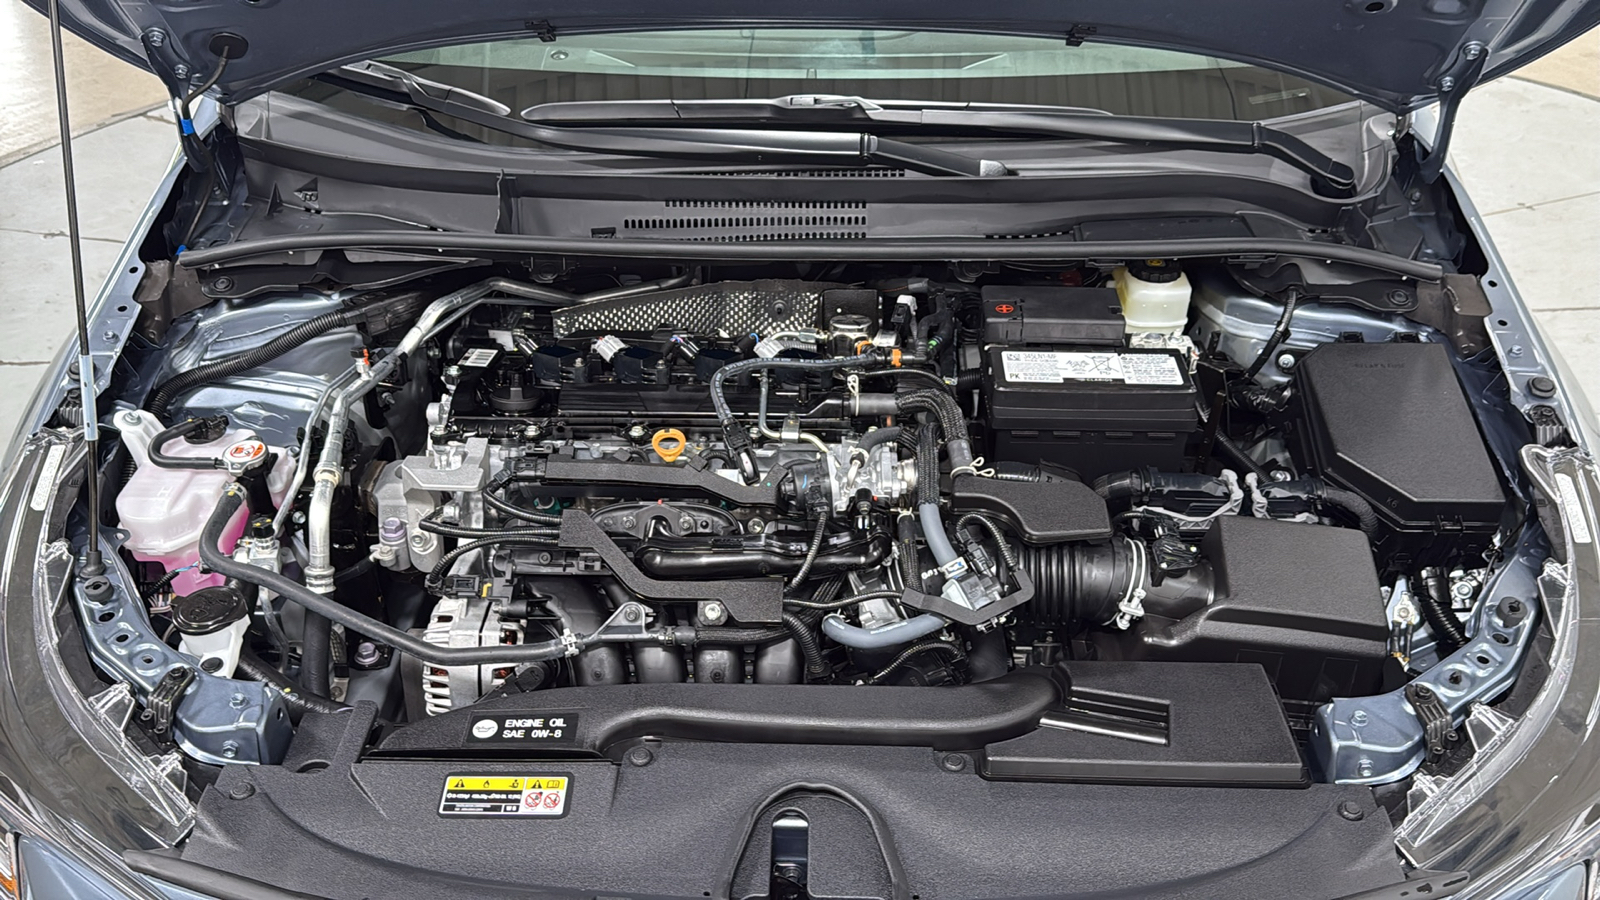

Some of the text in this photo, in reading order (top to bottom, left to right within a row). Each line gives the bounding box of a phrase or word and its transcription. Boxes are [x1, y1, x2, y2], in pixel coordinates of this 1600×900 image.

[504, 718, 567, 728] ENGINE OIL
[502, 729, 562, 738] SAE 0W-8
